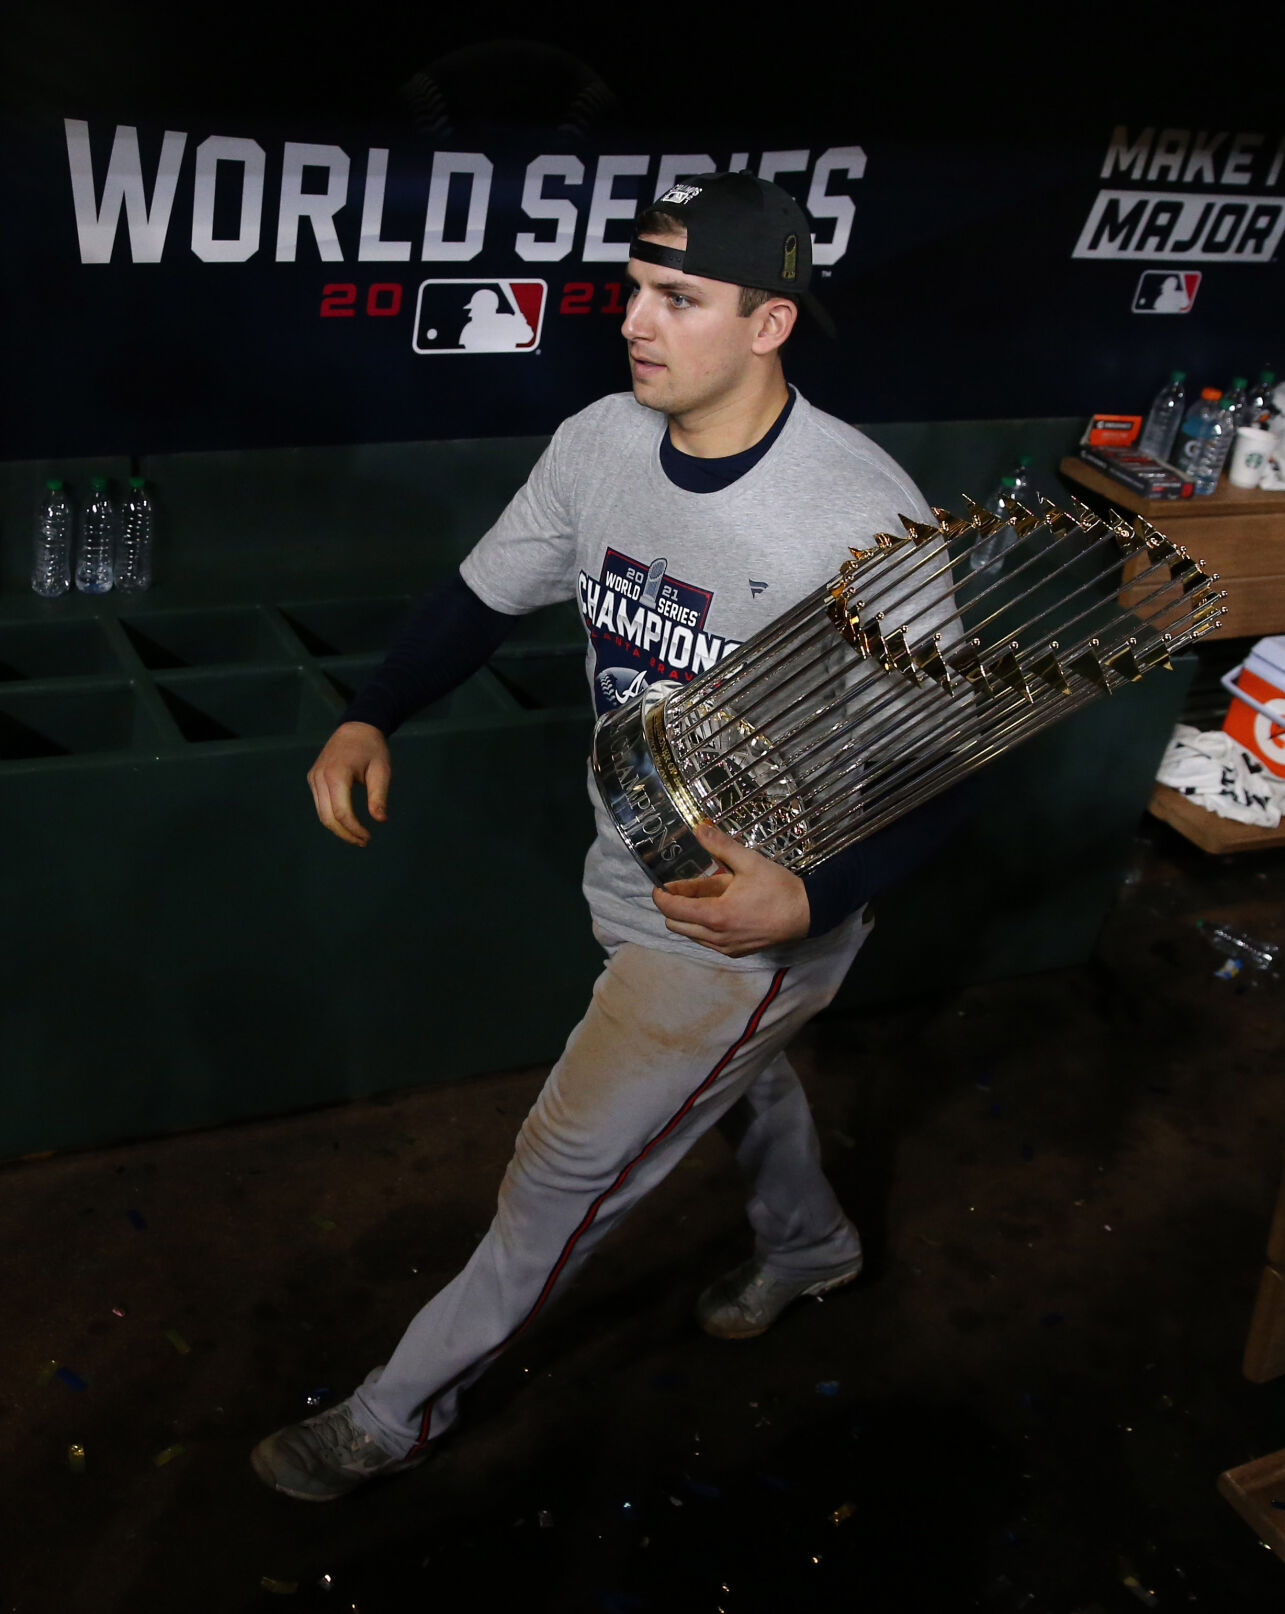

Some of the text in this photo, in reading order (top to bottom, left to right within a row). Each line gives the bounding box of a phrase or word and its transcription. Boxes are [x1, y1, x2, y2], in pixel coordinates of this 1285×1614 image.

[1101, 125, 1265, 185] MAKE
[64, 118, 495, 264] WORLD
[515, 146, 868, 264] SES
[1087, 198, 1283, 255] MAJOR
[321, 282, 625, 318] 20 21
[605, 570, 698, 627] WORLD SERIES
[626, 567, 679, 601] 20 21
[586, 618, 641, 659] LANTA
[610, 735, 683, 861] CHAMPIONS
